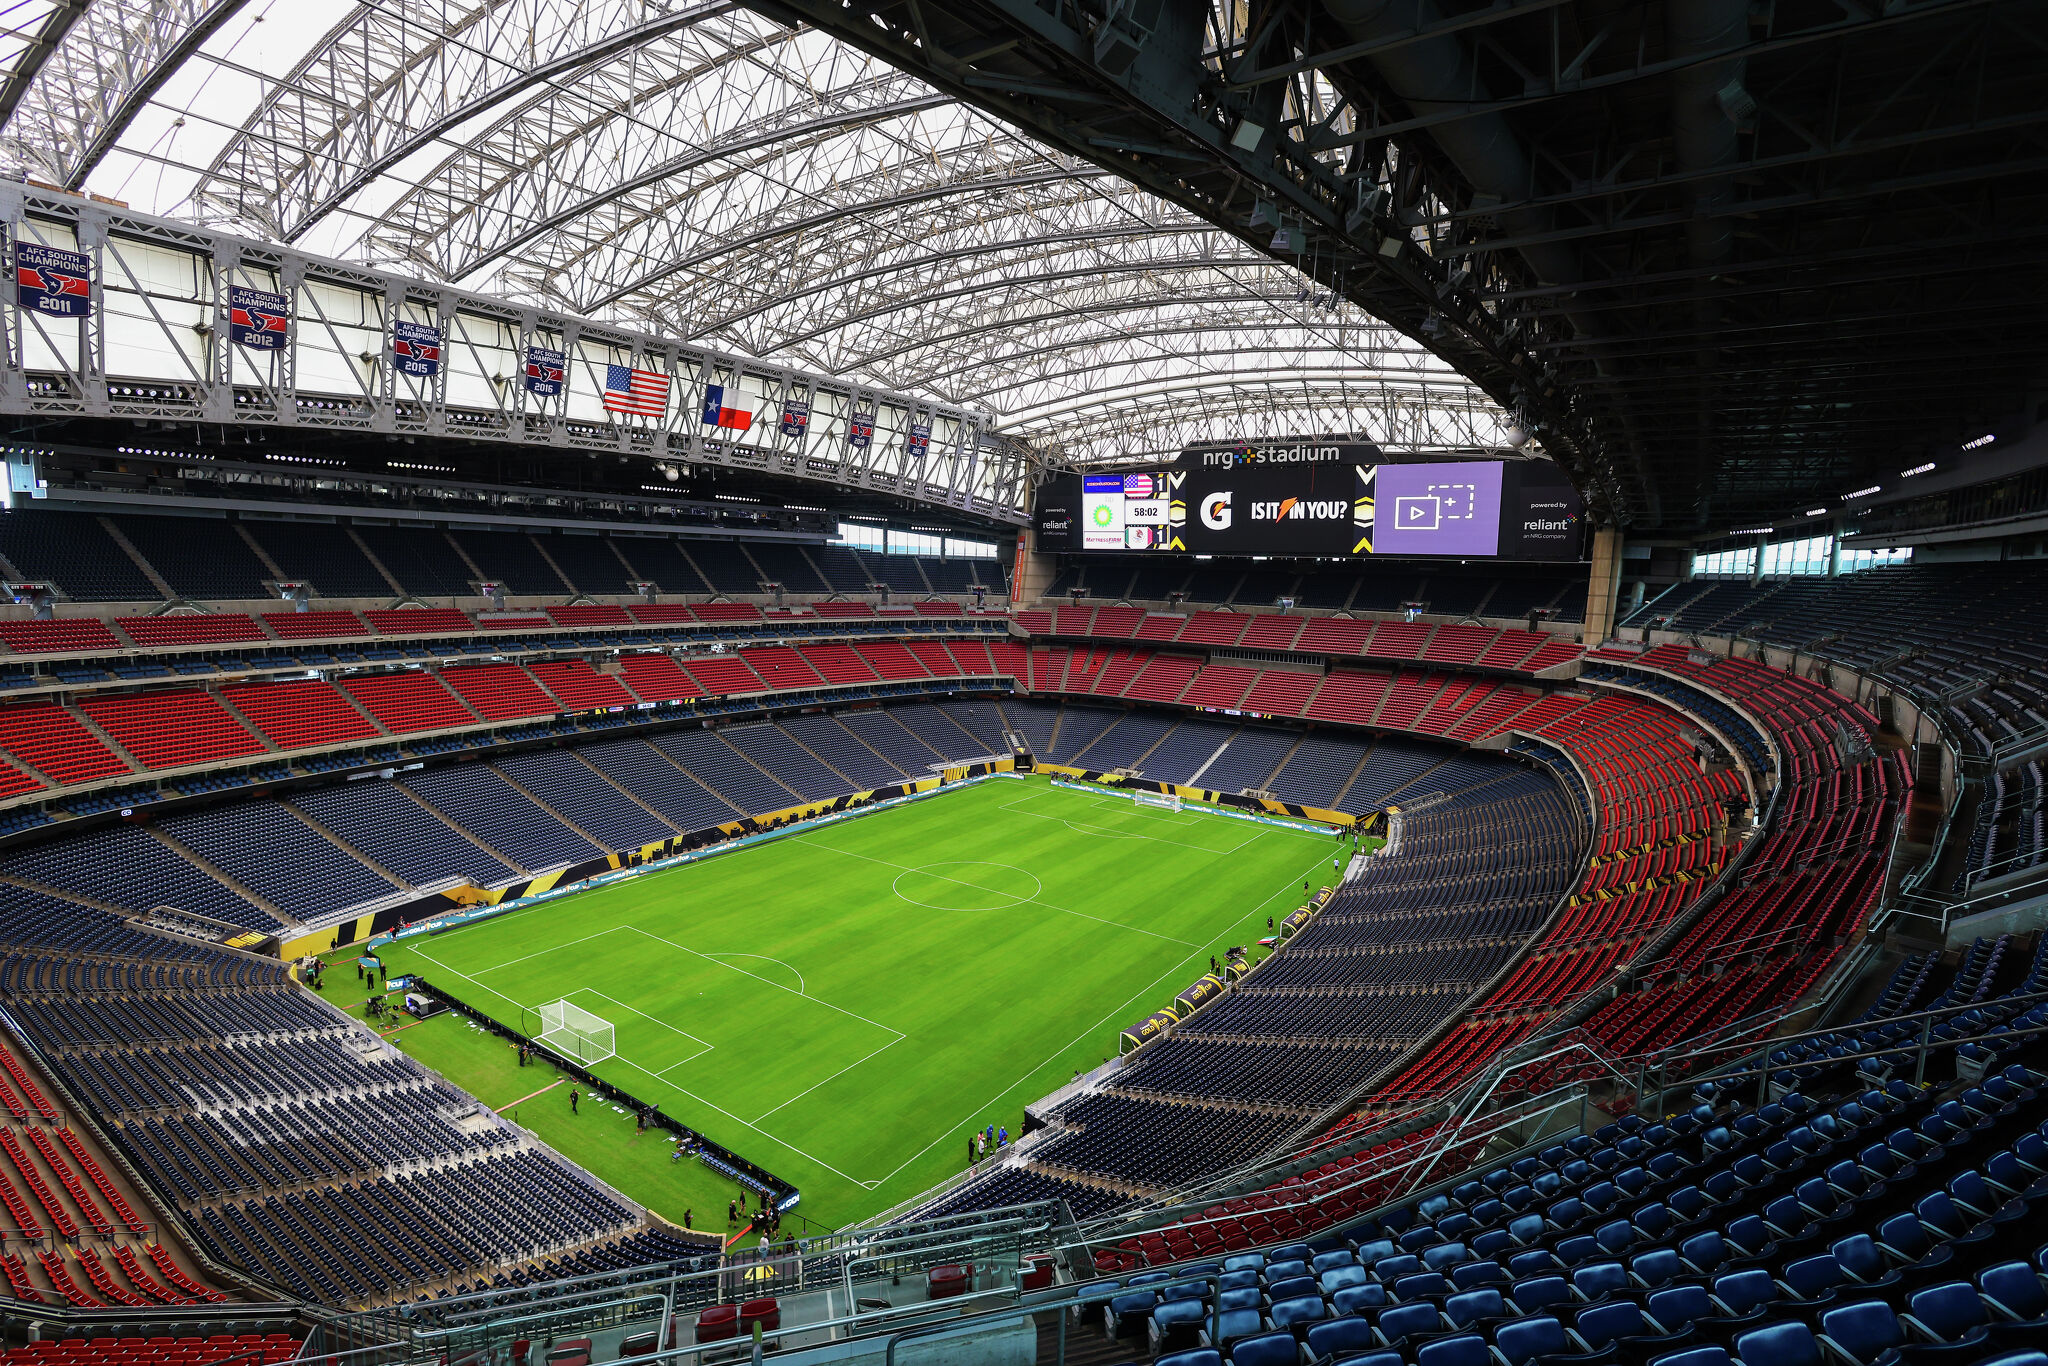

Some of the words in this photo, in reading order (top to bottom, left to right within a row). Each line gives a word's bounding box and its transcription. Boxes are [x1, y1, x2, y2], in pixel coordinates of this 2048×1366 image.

[26, 246, 45, 256] AFC
[48, 250, 80, 264] SOUTH
[18, 252, 86, 273] CHAMPIONS
[232, 295, 286, 312] CHAMPIONS
[238, 290, 254, 298] AFC
[255, 293, 280, 304] SOUTH
[40, 296, 71, 313] 2011
[398, 329, 439, 342] CHAMPIONS
[416, 326, 435, 335] SOUTH
[244, 332, 274, 346] 2012
[530, 354, 563, 365] CHAMPIONS
[405, 361, 428, 373] 2015
[534, 382, 553, 394] 2016
[1204, 451, 1233, 470] nrg
[1256, 445, 1339, 464] stadium
[1157, 478, 1162, 491] 1
[1134, 508, 1158, 516] 58:02
[1200, 491, 1232, 530] G
[1251, 502, 1265, 520] IS
[1266, 502, 1280, 520] IT
[1289, 502, 1305, 519] IN
[1306, 501, 1348, 519] YOU?
[1043, 520, 1068, 529] reliant
[1524, 519, 1567, 530] reliant
[1157, 530, 1162, 542] 1
[409, 926, 426, 935] GOLD
[1141, 1026, 1155, 1036] GOLD
[1159, 1017, 1168, 1026] CUP
